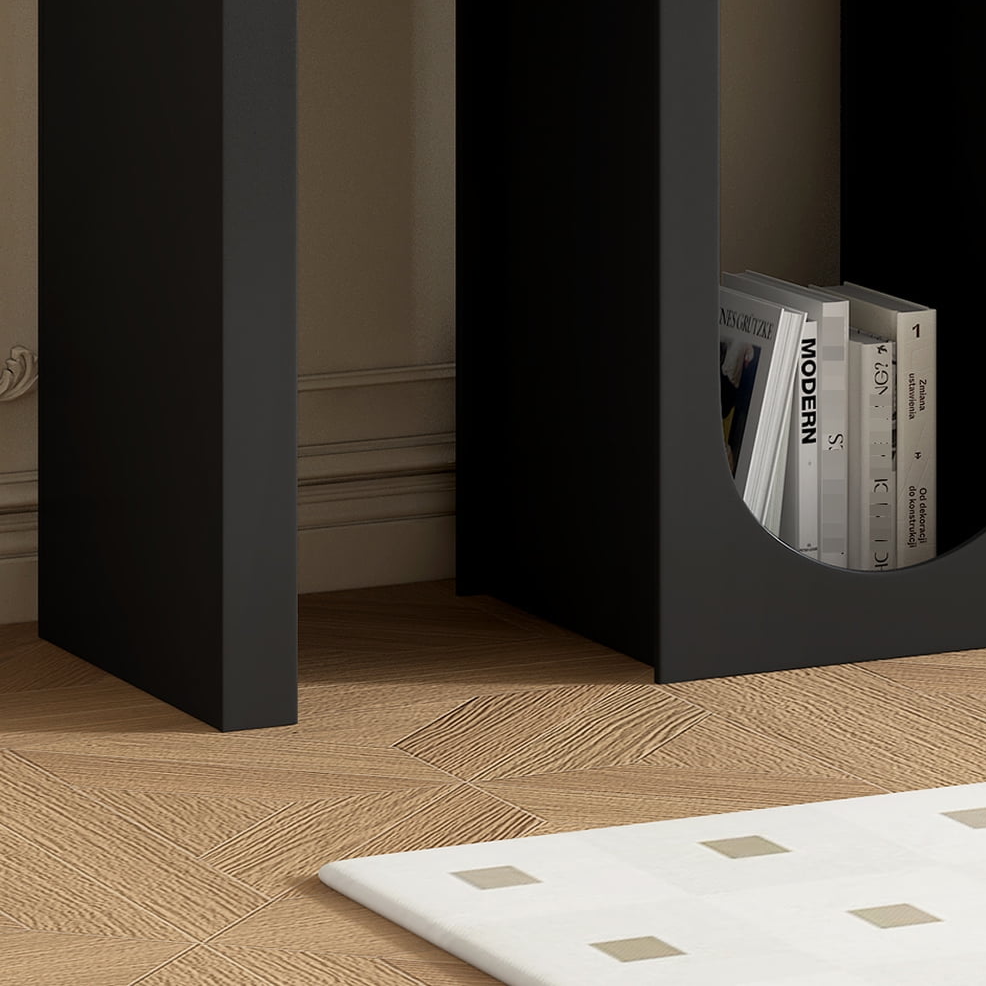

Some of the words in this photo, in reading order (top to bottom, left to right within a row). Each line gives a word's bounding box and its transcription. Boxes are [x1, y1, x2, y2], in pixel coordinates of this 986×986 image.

[912, 323, 920, 338] 1
[801, 338, 817, 444] MODERN
[908, 373, 917, 420] ustawienia
[919, 379, 927, 412] Zmiana
[908, 486, 917, 497] do
[919, 488, 927, 500] Od
[907, 498, 917, 548] konstrukcji
[918, 502, 927, 544] dekoracji
